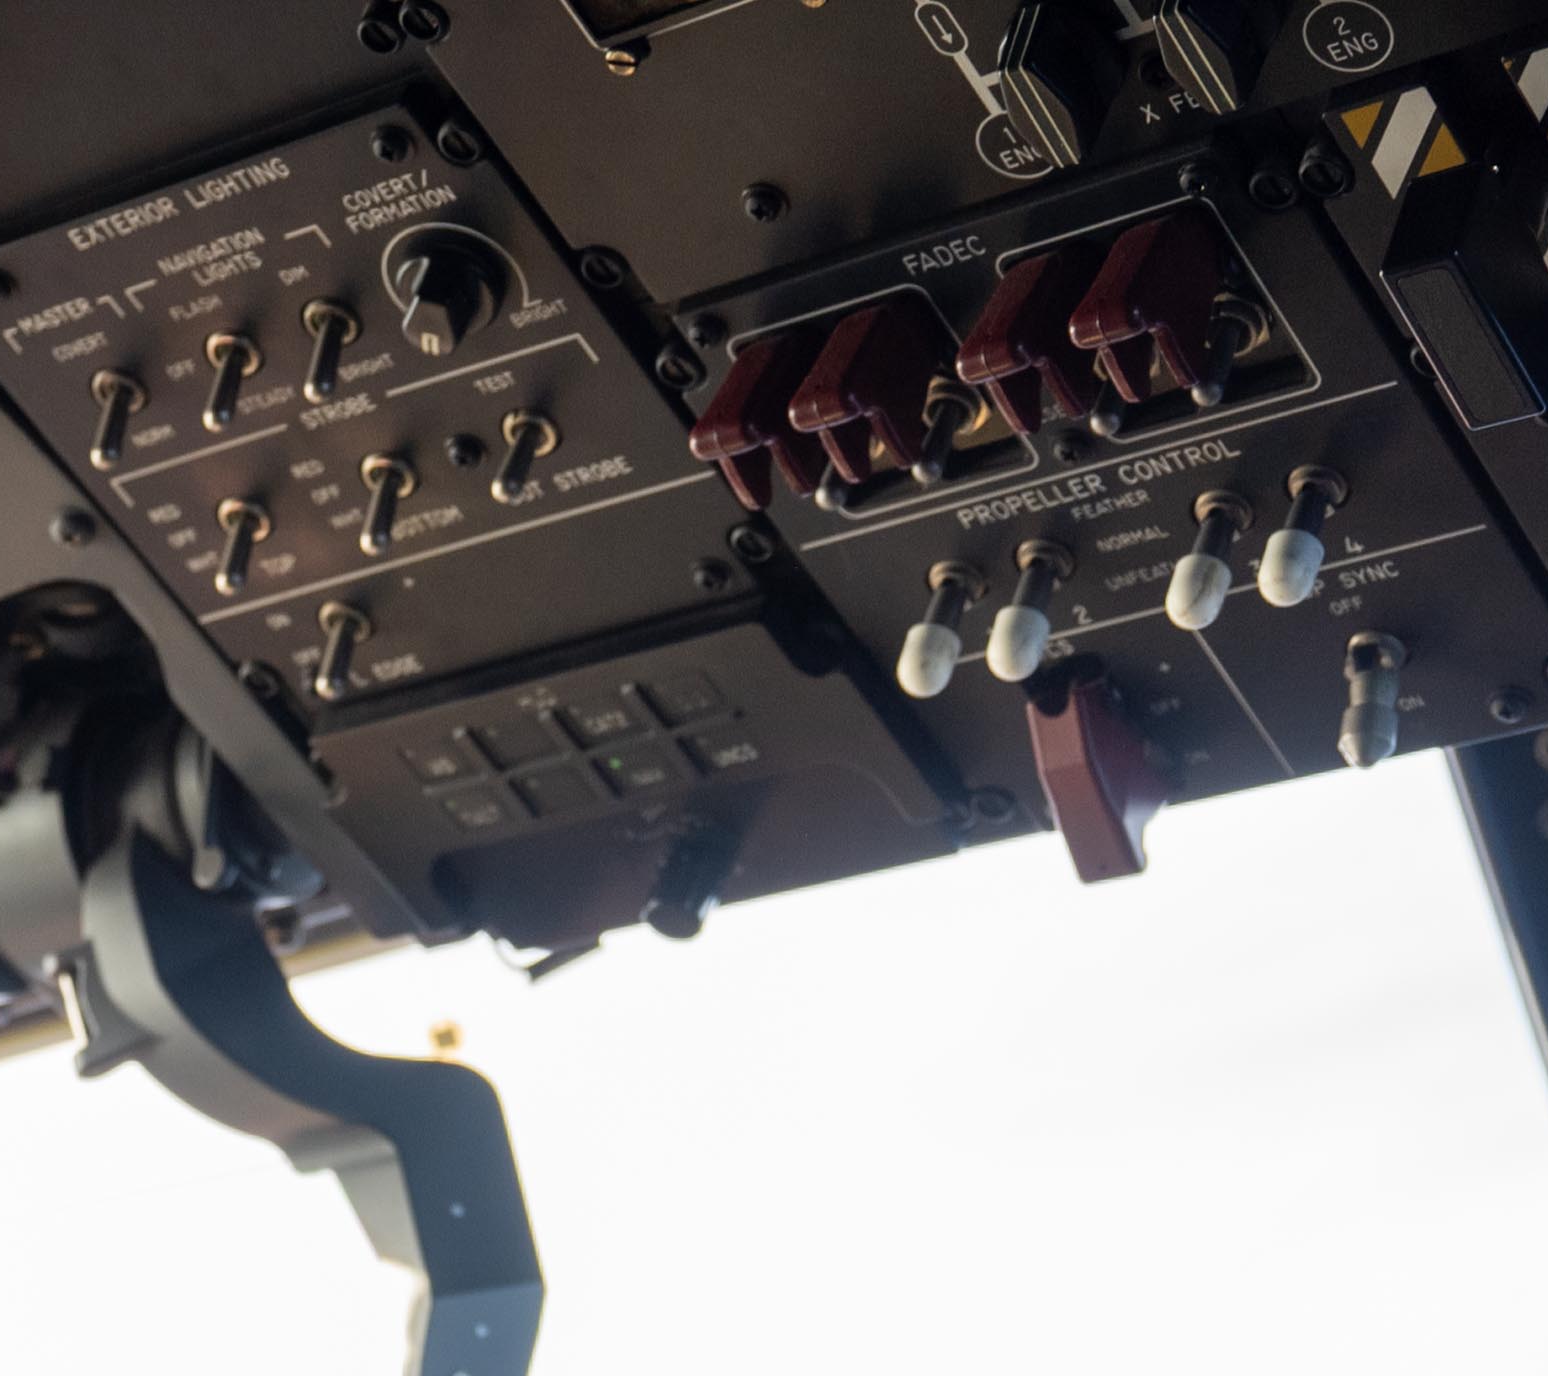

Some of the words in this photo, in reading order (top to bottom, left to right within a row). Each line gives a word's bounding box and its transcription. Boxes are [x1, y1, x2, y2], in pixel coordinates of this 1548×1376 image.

[1332, 16, 1350, 36] 2
[1326, 33, 1378, 64] ENG
[1140, 104, 1160, 125] X
[999, 145, 1041, 170] EN
[67, 196, 180, 251] EXTERIOR
[183, 157, 290, 209] LIGHTING
[345, 185, 456, 234] FORMATION
[157, 228, 265, 276] NAVIGATION
[902, 234, 987, 277] FADEC
[192, 251, 263, 287] LIGHTS
[17, 297, 94, 334] MASTER
[168, 295, 224, 322] FLASH
[509, 300, 569, 330] BRIGHT
[51, 331, 109, 363] COVERT
[165, 359, 197, 381] OFF
[337, 353, 395, 383] BRIGHT
[473, 371, 516, 395] TEST
[300, 392, 377, 430] STROBE
[553, 455, 633, 492] STROBE
[956, 472, 1106, 530] PROPELLER
[1117, 439, 1243, 487] CONTROL
[1070, 489, 1151, 522] FEATHER
[1096, 524, 1171, 553] NORMAL
[1344, 536, 1365, 553] 4
[1339, 561, 1400, 590] SYNC
[1071, 605, 1094, 625] 2
[1329, 595, 1363, 616] OFF
